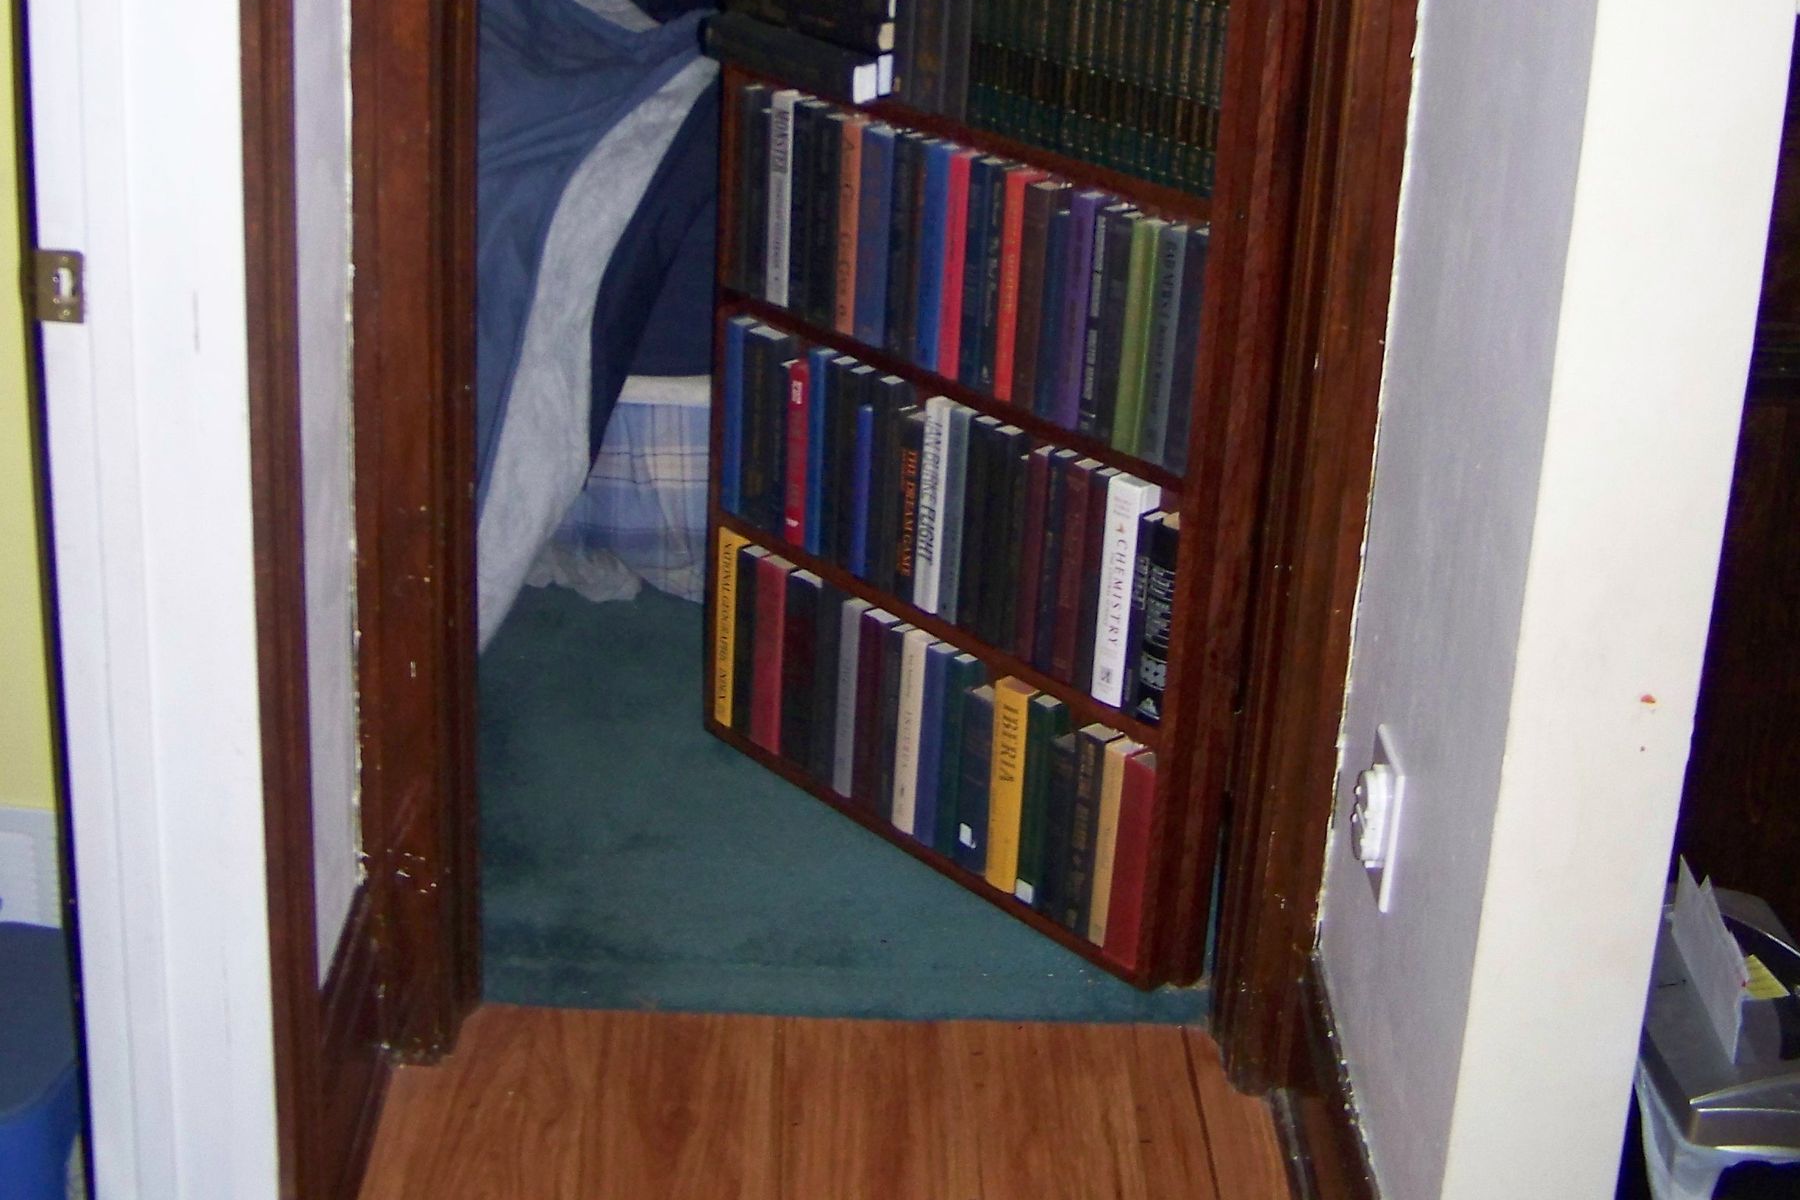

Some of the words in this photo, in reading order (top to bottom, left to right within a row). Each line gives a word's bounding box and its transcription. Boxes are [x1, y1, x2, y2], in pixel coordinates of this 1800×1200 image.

[773, 107, 791, 174] MONSTER
[905, 450, 919, 475] THE
[921, 450, 940, 503] BURKE
[902, 479, 917, 534] DREAM
[899, 535, 913, 577] GAME
[917, 504, 937, 567] FLIGHT
[721, 542, 733, 593] NATIONAL
[1107, 539, 1129, 649] CHEMISTRY
[718, 595, 731, 663] GEOGRAPHIC
[718, 667, 728, 703] INDEX
[999, 703, 1021, 783] IBERIA
